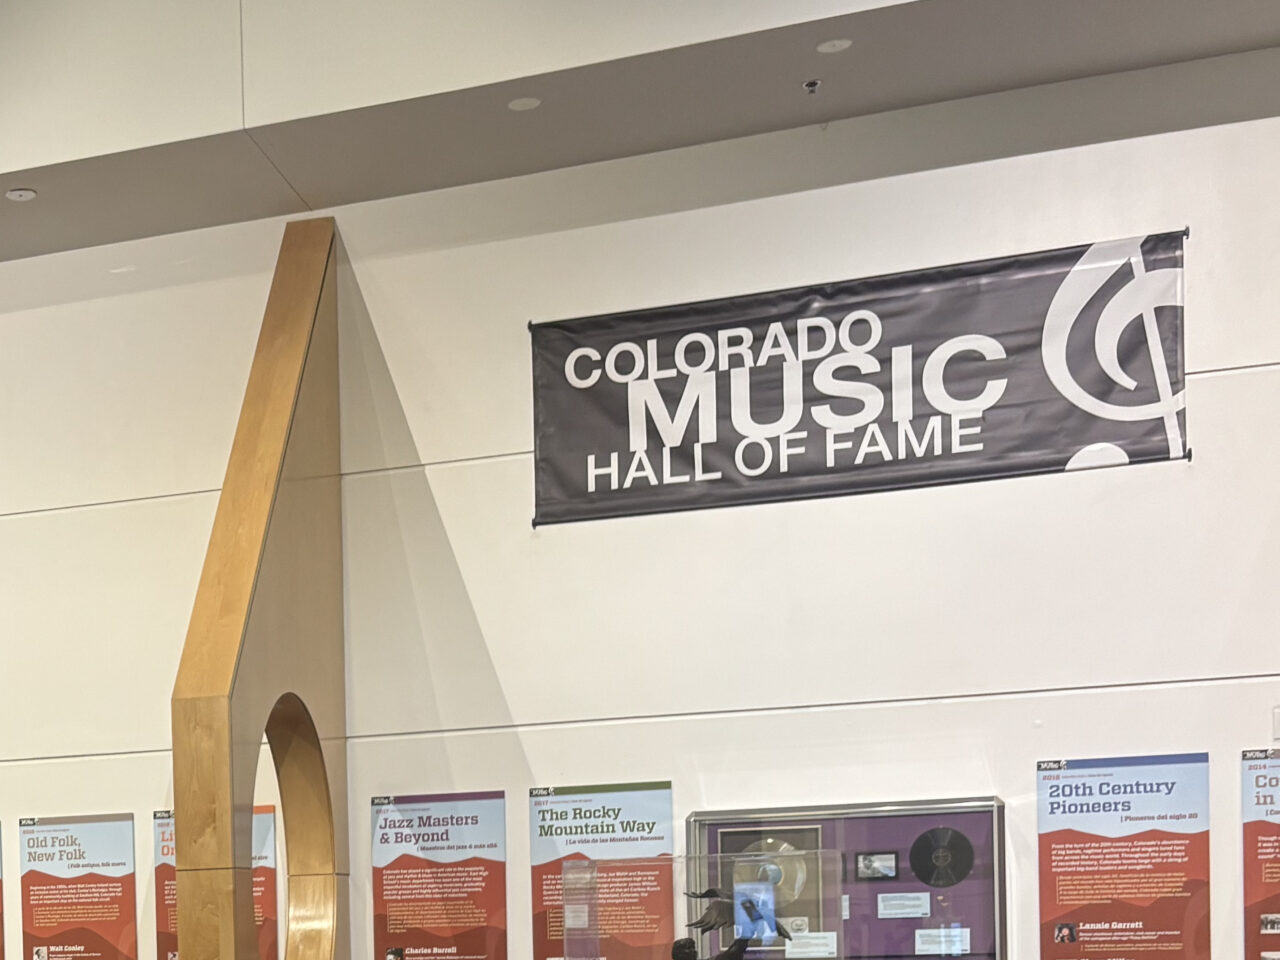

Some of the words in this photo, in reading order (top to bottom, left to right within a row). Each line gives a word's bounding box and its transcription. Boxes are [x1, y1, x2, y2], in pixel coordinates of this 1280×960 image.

[564, 310, 883, 389] COLORADO
[628, 334, 1008, 452] MUSIC
[587, 439, 721, 493] HALL
[735, 432, 807, 477] OF
[826, 410, 984, 468] FAME
[1255, 775, 1279, 788] Co
[1049, 782, 1094, 798] 20th
[1099, 781, 1176, 795] Century
[1255, 791, 1275, 805] in
[538, 809, 568, 822] The
[572, 806, 621, 820] Rocky
[1049, 800, 1131, 815] Pioneers
[379, 817, 414, 830] Jazz
[418, 815, 479, 827] Masters
[539, 822, 616, 836] Mountain
[620, 821, 656, 834] Way
[27, 838, 48, 848] Old
[51, 836, 81, 847] Folk,
[161, 831, 175, 842] Li
[380, 833, 390, 844] &
[394, 829, 449, 845] Beyond
[27, 851, 55, 862] New
[59, 849, 86, 860] Folk
